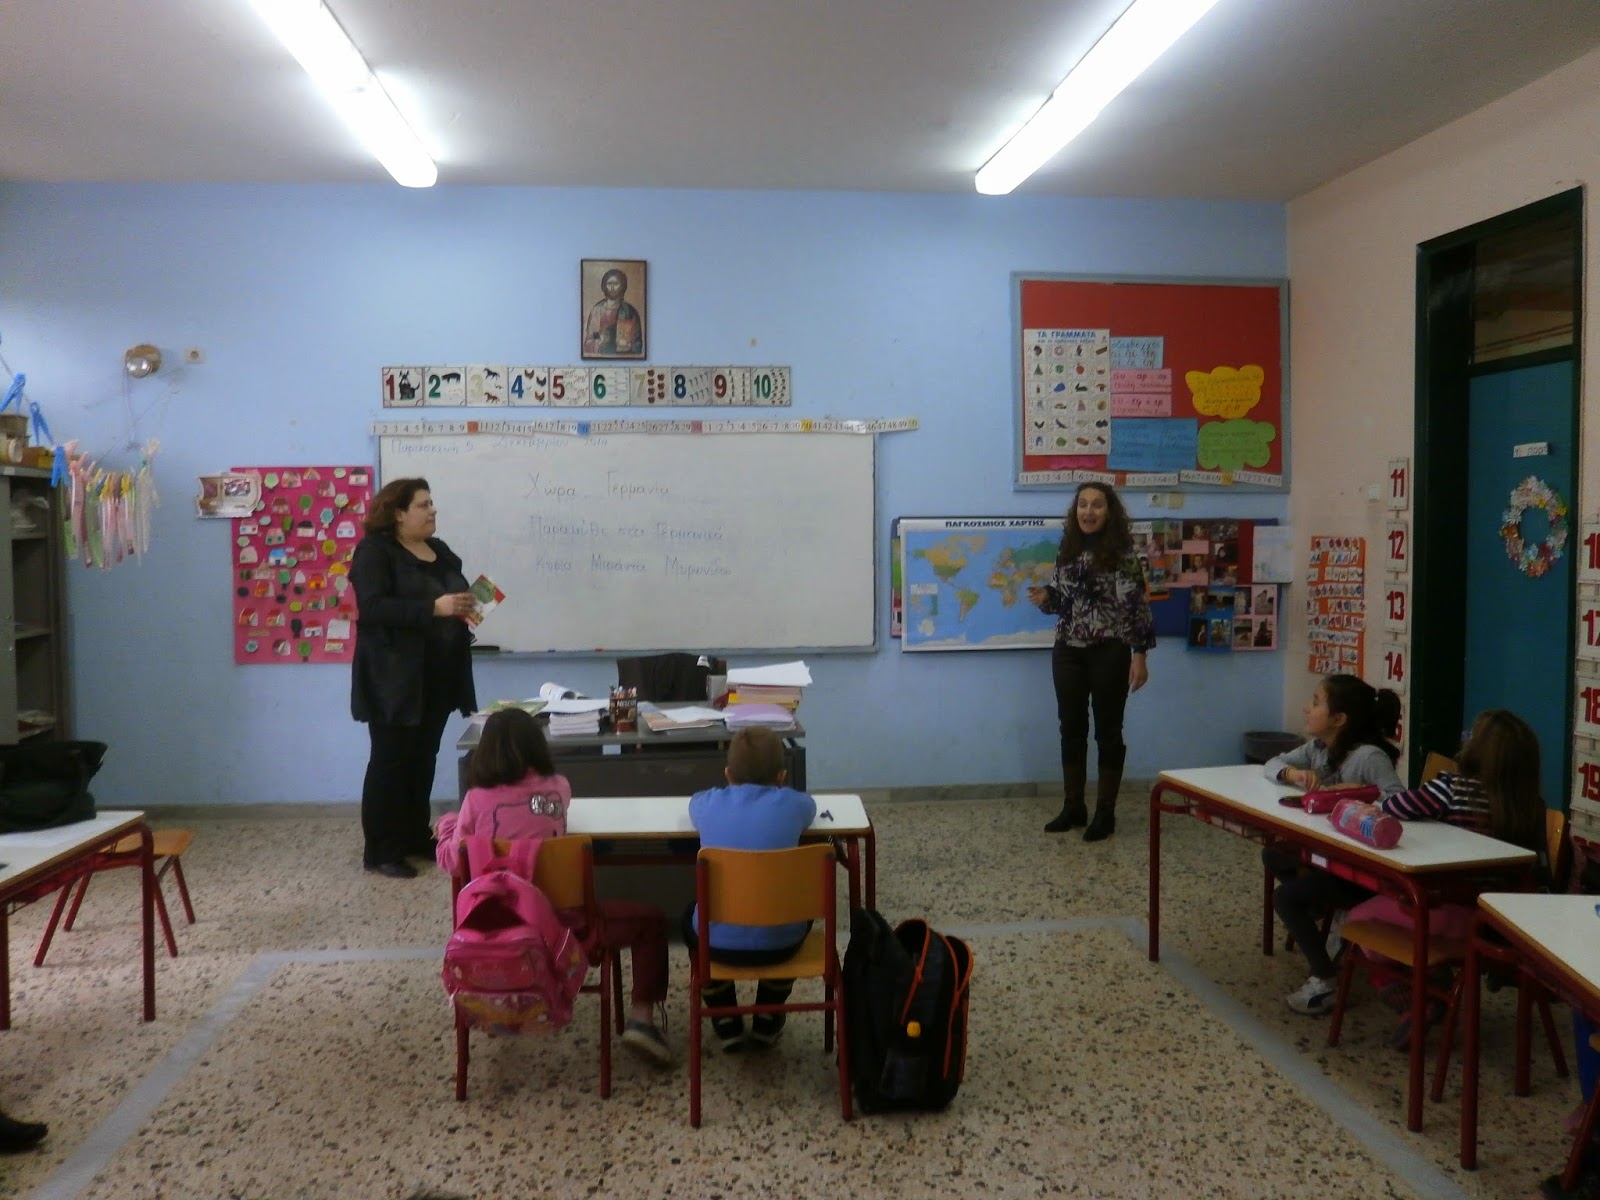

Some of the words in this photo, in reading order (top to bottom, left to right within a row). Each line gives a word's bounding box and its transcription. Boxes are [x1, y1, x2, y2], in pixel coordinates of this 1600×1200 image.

[385, 375, 395, 399] 1
[428, 375, 441, 398] 2
[469, 375, 483, 397] 3
[510, 375, 524, 398] 4
[552, 375, 565, 399] 5
[593, 375, 606, 398] 6
[634, 375, 646, 398] 7
[674, 375, 686, 399] 8
[714, 375, 727, 398] 9
[753, 375, 771, 398] 10
[1390, 468, 1405, 498] 11
[945, 520, 1006, 528] ΠΑΓΚΟΣΜΙΟΣ
[1008, 519, 1046, 527] ΧΑΡΤΗΣ
[1388, 530, 1404, 560] 12
[1584, 532, 1600, 569] 1
[1386, 590, 1404, 621] 13
[1384, 651, 1404, 682] 14
